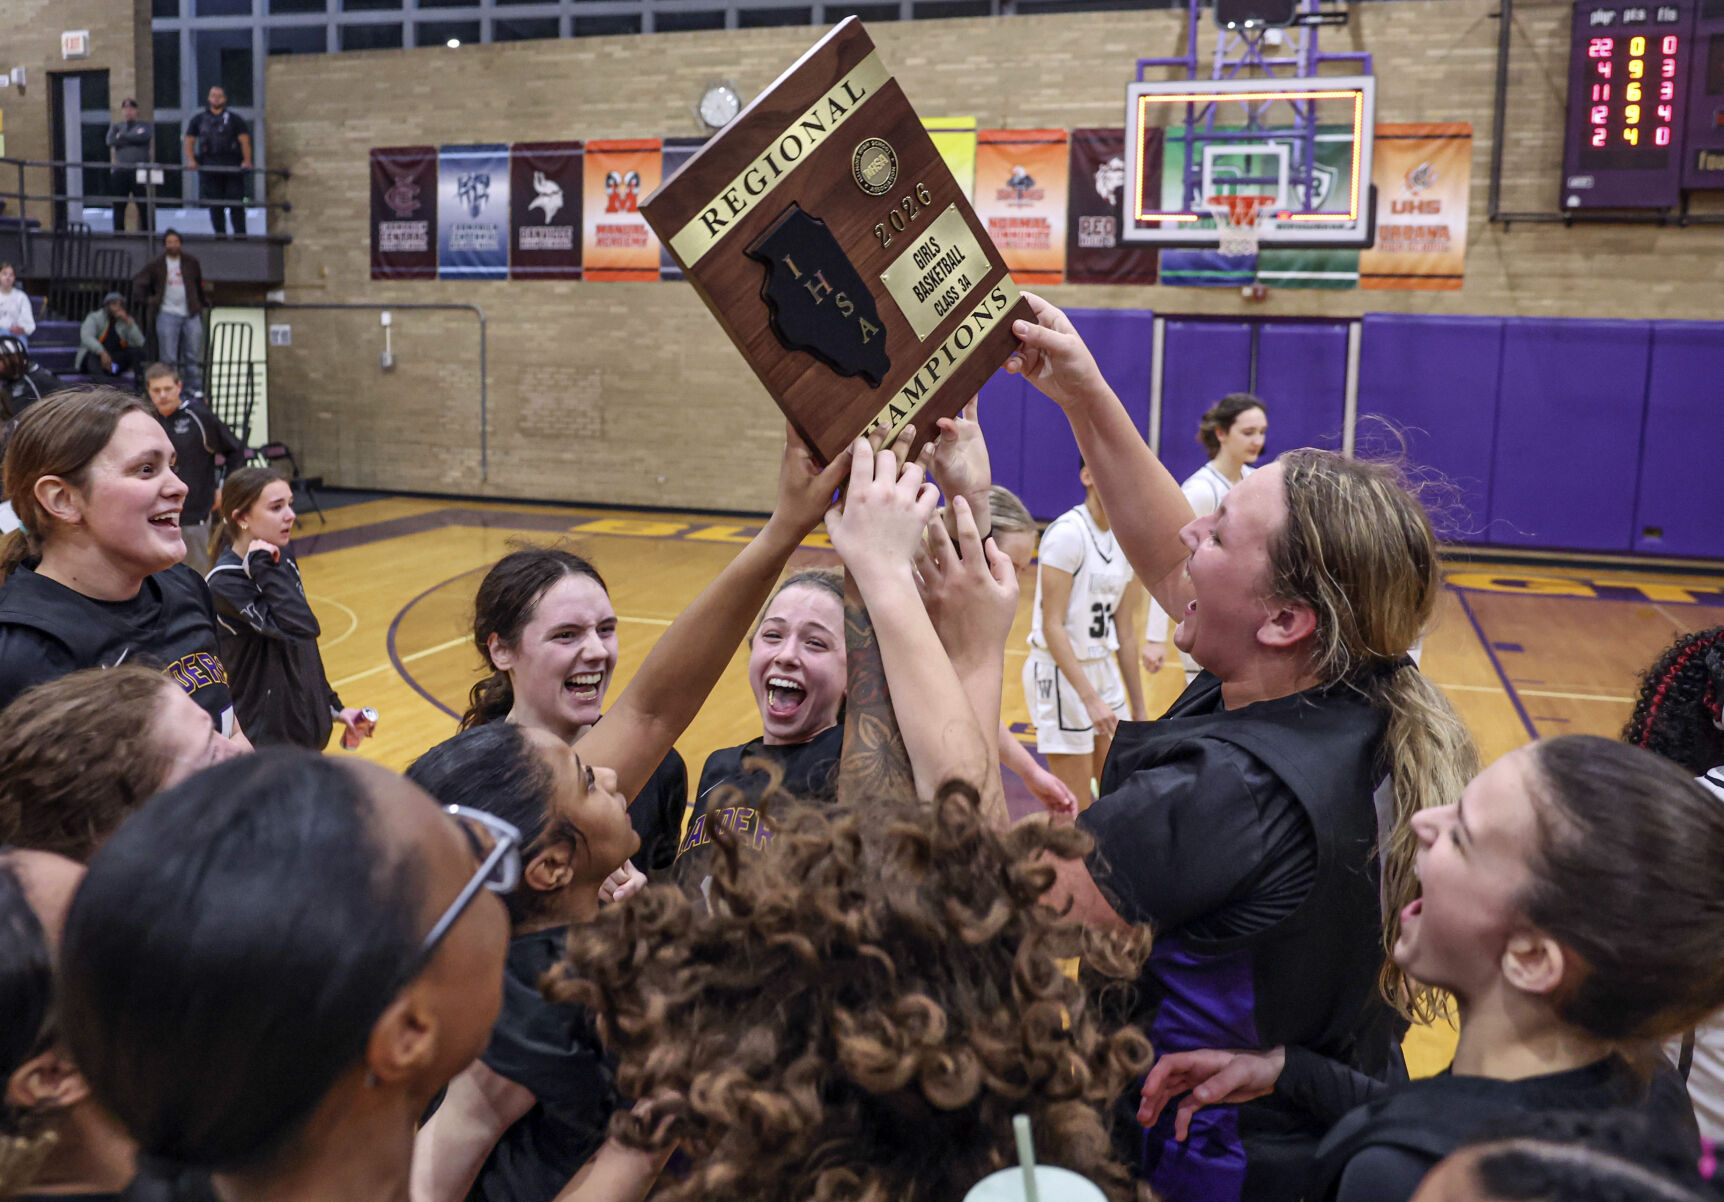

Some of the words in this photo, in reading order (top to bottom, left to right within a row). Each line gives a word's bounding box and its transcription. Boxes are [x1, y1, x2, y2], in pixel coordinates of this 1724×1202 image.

[1588, 38, 1614, 57] 22
[1629, 36, 1646, 57] 0
[1662, 35, 1678, 55] 0
[1597, 61, 1612, 79] 4
[1628, 59, 1644, 79] 9
[1661, 58, 1676, 78] 3
[1592, 83, 1610, 102] 11
[1625, 81, 1642, 102] 6
[1659, 81, 1674, 100] 3
[1590, 104, 1609, 125] 12
[1624, 104, 1641, 125] 9
[1657, 104, 1672, 122] 4
[1591, 127, 1607, 147] 2
[1623, 127, 1639, 146] 4
[1655, 126, 1670, 146] 0
[698, 80, 866, 239] REGIONAL
[873, 182, 932, 248] 2026
[1391, 200, 1441, 214] UHS
[1079, 217, 1116, 235] PEO
[1379, 225, 1451, 241] URBANA
[912, 236, 941, 270] GIRLS
[912, 245, 966, 303] BASKETBALL
[933, 286, 960, 317] CLASS
[957, 274, 973, 293] 3A
[861, 286, 1007, 438] AMPIONS
[1037, 679, 1053, 698] W
